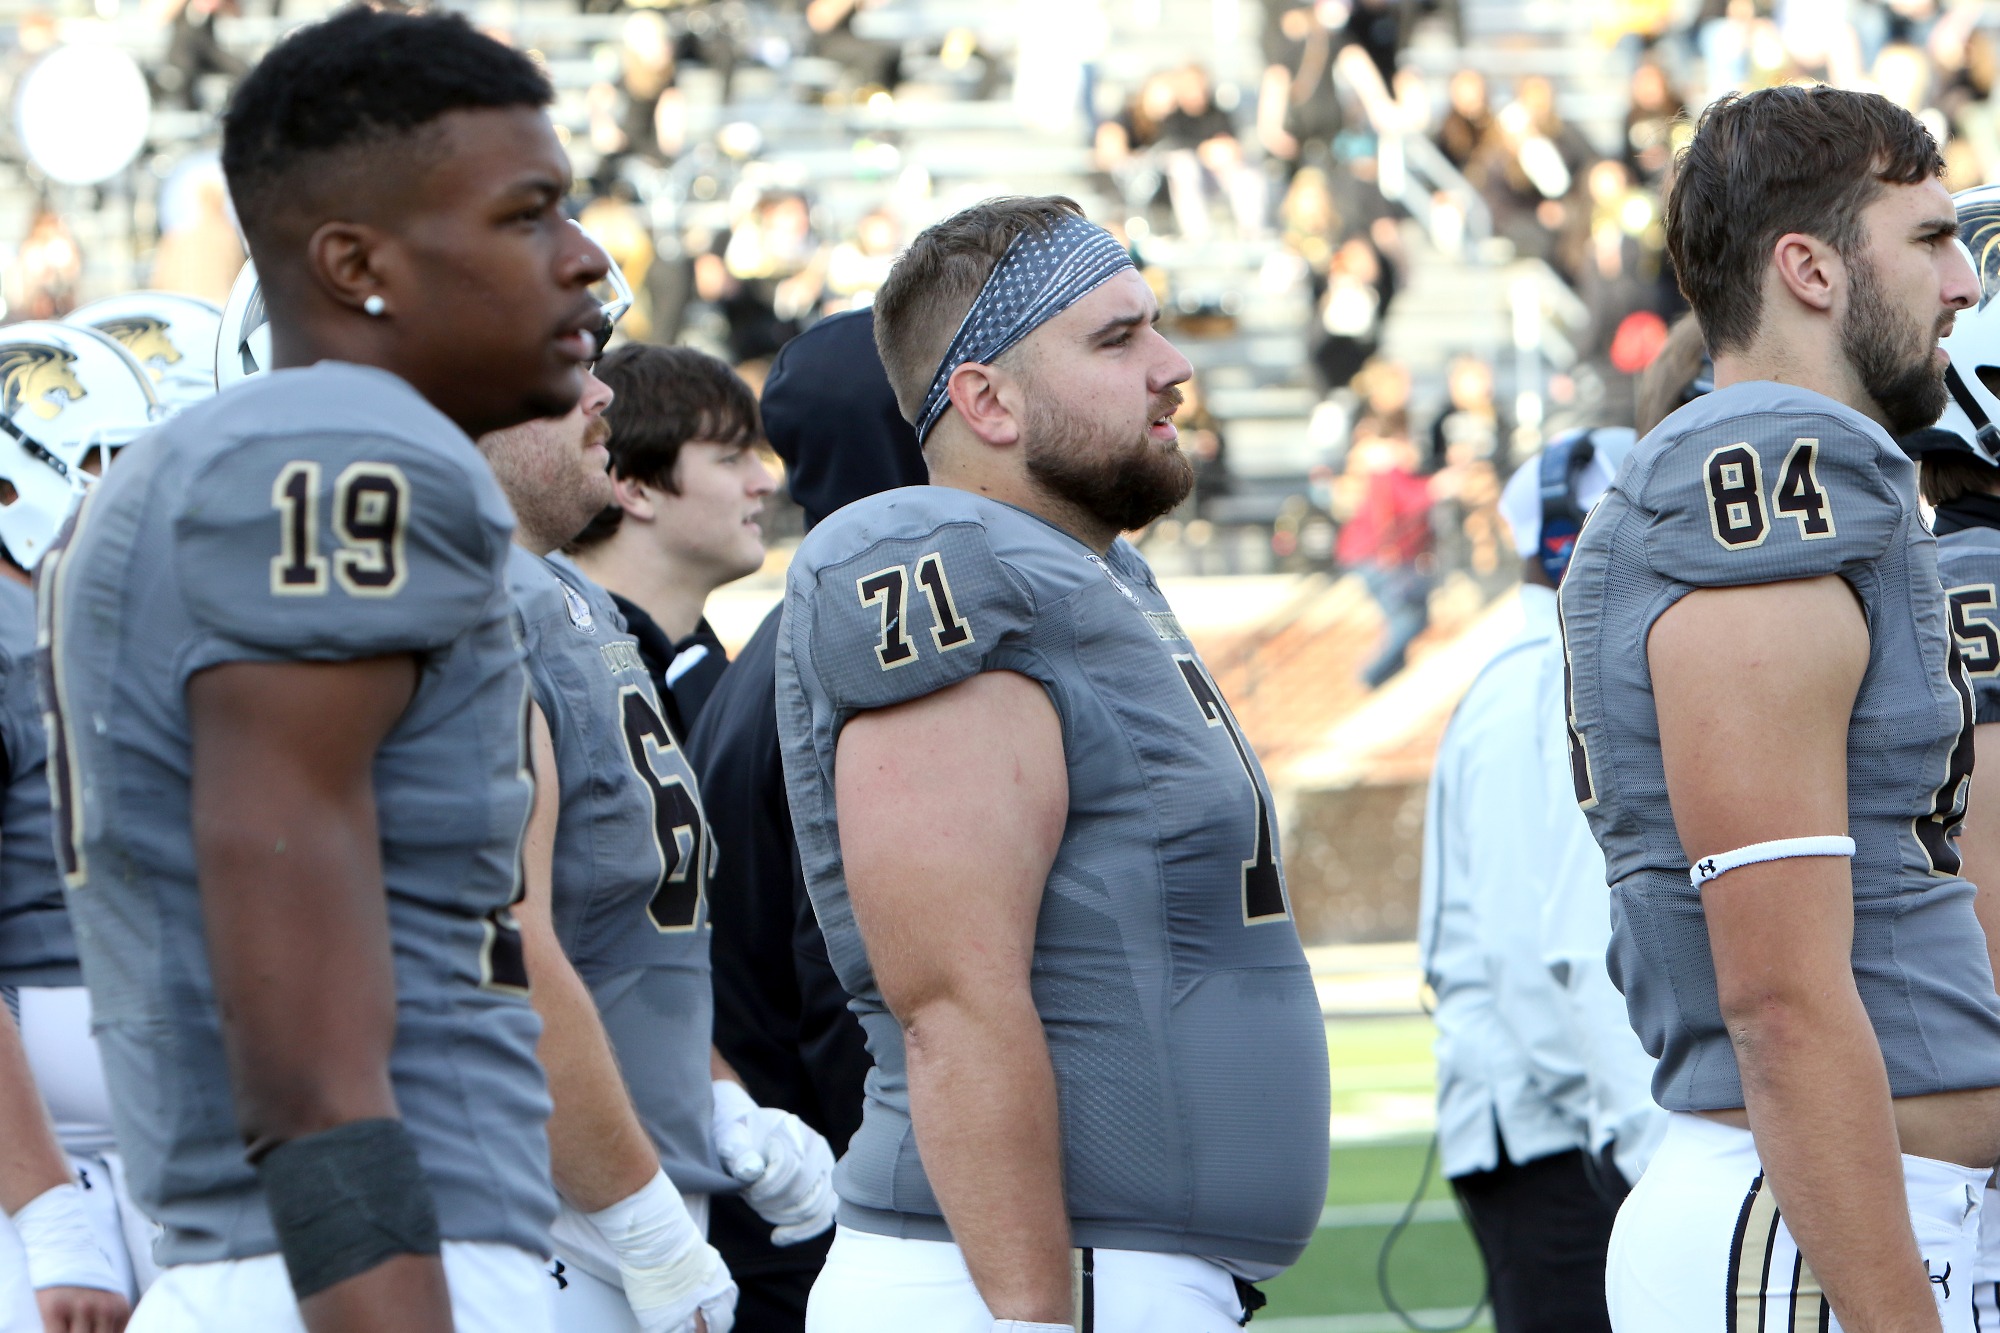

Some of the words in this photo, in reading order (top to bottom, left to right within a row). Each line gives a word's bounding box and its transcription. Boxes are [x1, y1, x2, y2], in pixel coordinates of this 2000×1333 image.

[271, 461, 409, 597] 19
[1703, 438, 1837, 551] 84
[856, 551, 974, 672] 71
[618, 684, 720, 934] 6
